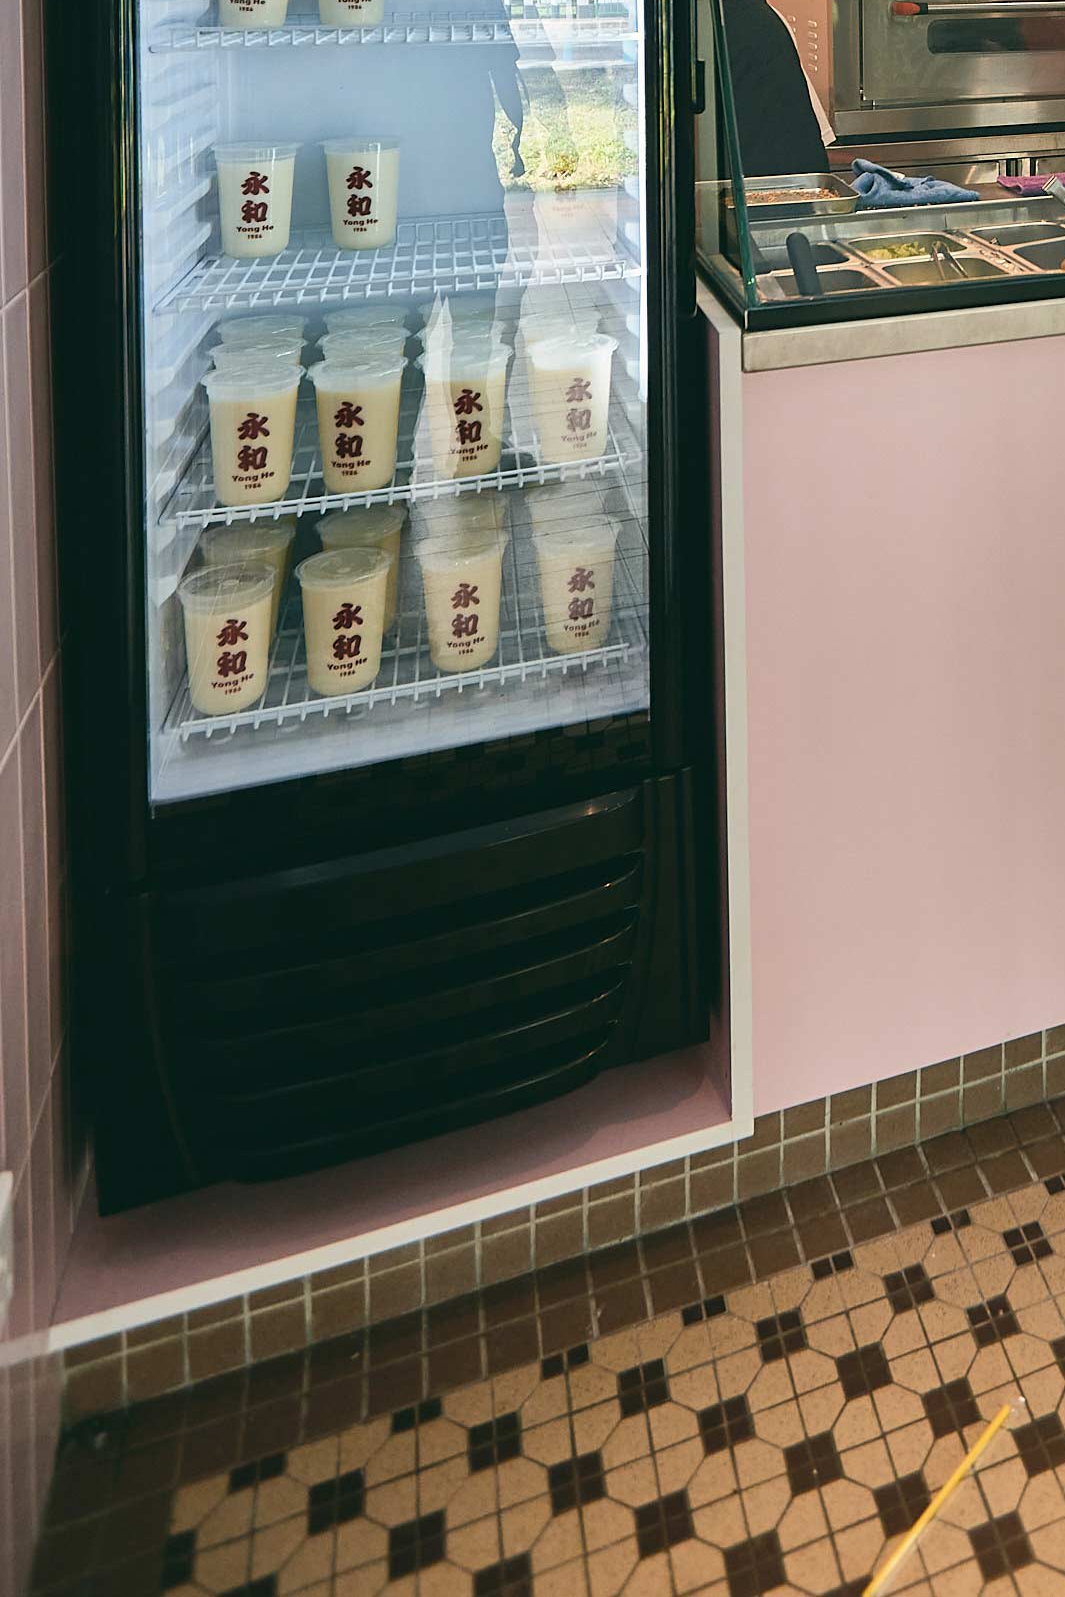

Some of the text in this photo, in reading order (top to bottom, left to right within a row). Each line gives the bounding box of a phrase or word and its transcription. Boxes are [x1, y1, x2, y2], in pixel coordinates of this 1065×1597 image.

[241, 171, 269, 224] 永和
[346, 166, 373, 218] 永和
[236, 224, 274, 234] Yong He
[237, 412, 270, 471] 永和
[334, 402, 365, 459] 永和
[454, 389, 483, 445] 永和
[231, 470, 275, 486] Yong He
[332, 602, 364, 660] 永和
[451, 583, 480, 639] 永和
[217, 618, 249, 677] 永和
[211, 673, 254, 690] Yong He
